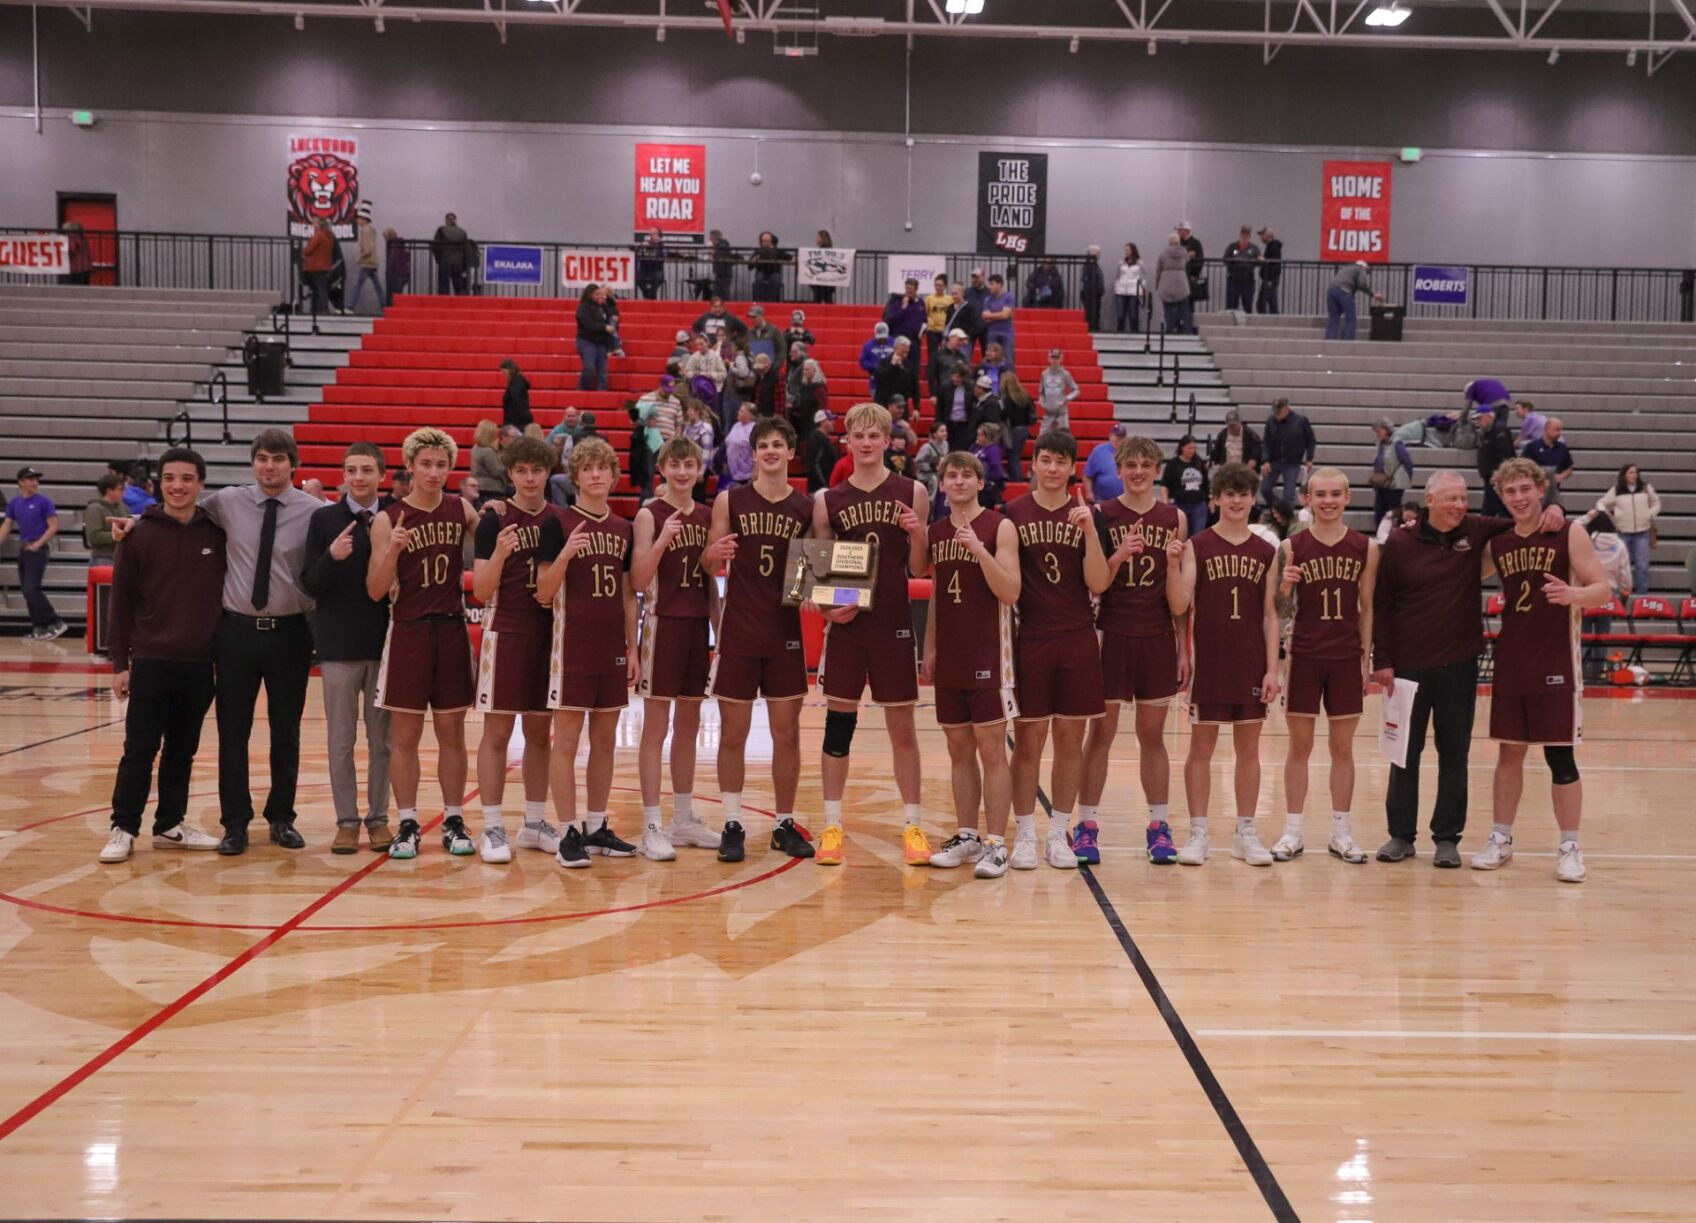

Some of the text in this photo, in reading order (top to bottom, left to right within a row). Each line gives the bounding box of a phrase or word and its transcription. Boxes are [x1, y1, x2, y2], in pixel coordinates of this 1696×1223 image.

[650, 157, 690, 174] LET ME
[998, 159, 1029, 182] THE
[640, 176, 700, 194] HEAR YOU
[988, 182, 1037, 205] PRIDE
[1330, 175, 1383, 199] HOME
[646, 197, 693, 220] ROAR
[990, 205, 1033, 228] LAND
[1340, 206, 1371, 220] OF THE
[995, 231, 1028, 252] LHS
[1328, 228, 1382, 252] LIONS
[0, 241, 64, 267] GUEST
[494, 260, 534, 270] EKALAKA
[565, 255, 631, 282] GUEST
[901, 269, 935, 280] TERRY
[1415, 278, 1466, 292] ROBERTS
[739, 512, 802, 540] BRIDGER
[839, 500, 902, 531] BRIDGER
[1019, 520, 1084, 548] BRIDGER
[420, 554, 449, 588] 10
[680, 555, 703, 588] 14
[758, 544, 775, 577] 5
[1044, 552, 1061, 584] 3
[1126, 554, 1156, 587] 12
[1205, 554, 1266, 584] BRIDGER
[1300, 556, 1361, 584] BRIDGER
[1499, 546, 1556, 578] BRIDGER
[591, 563, 617, 597] 15
[947, 569, 962, 604] 4
[1230, 586, 1241, 620] 1
[1320, 587, 1344, 620] 11
[1516, 580, 1532, 612] 2
[1643, 599, 1663, 612] LHS
